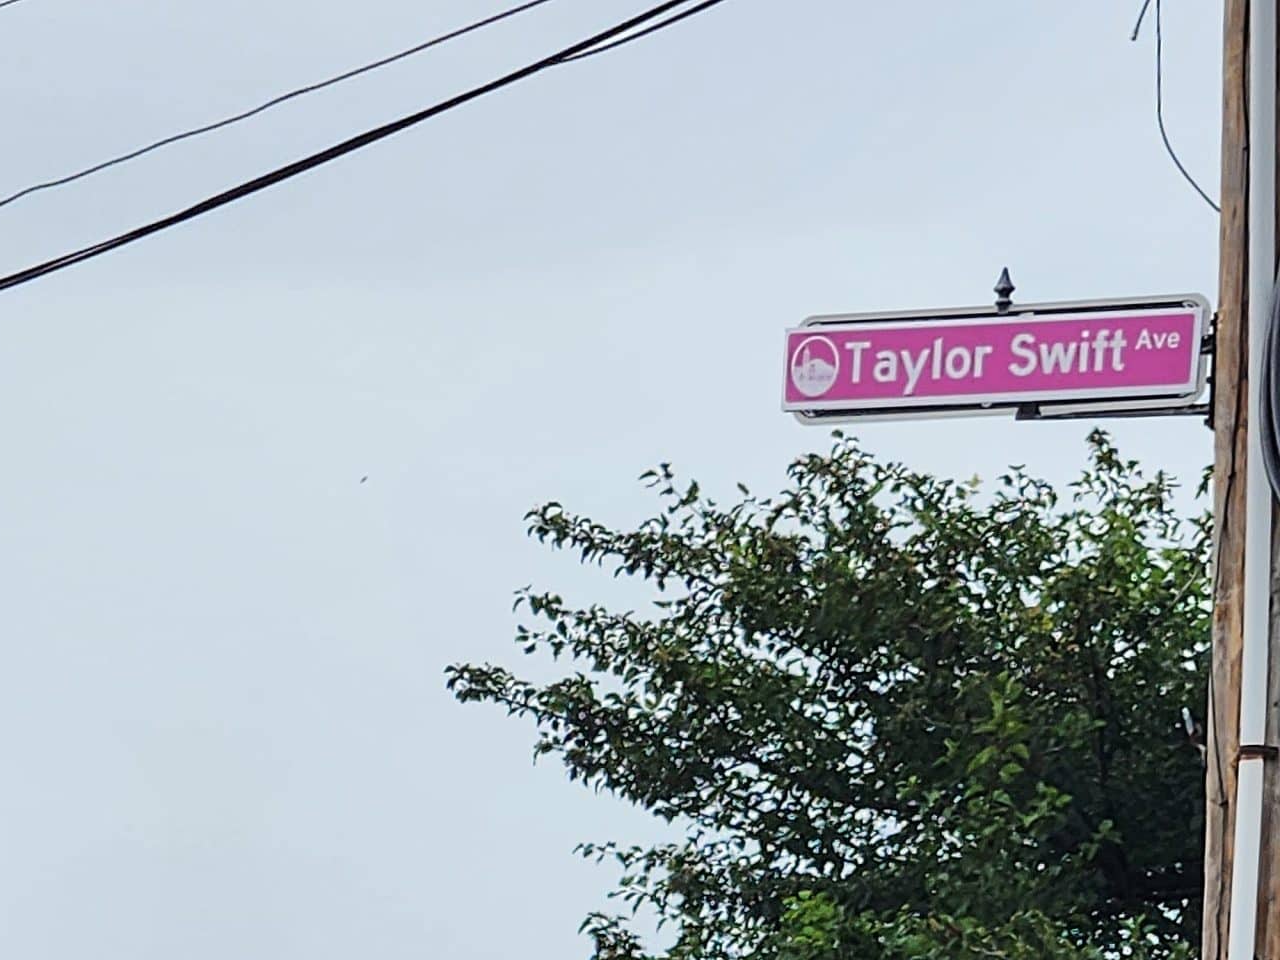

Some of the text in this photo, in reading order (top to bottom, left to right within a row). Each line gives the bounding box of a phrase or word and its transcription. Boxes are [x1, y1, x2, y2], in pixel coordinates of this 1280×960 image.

[845, 328, 1181, 396] Taylor Swift Ave
